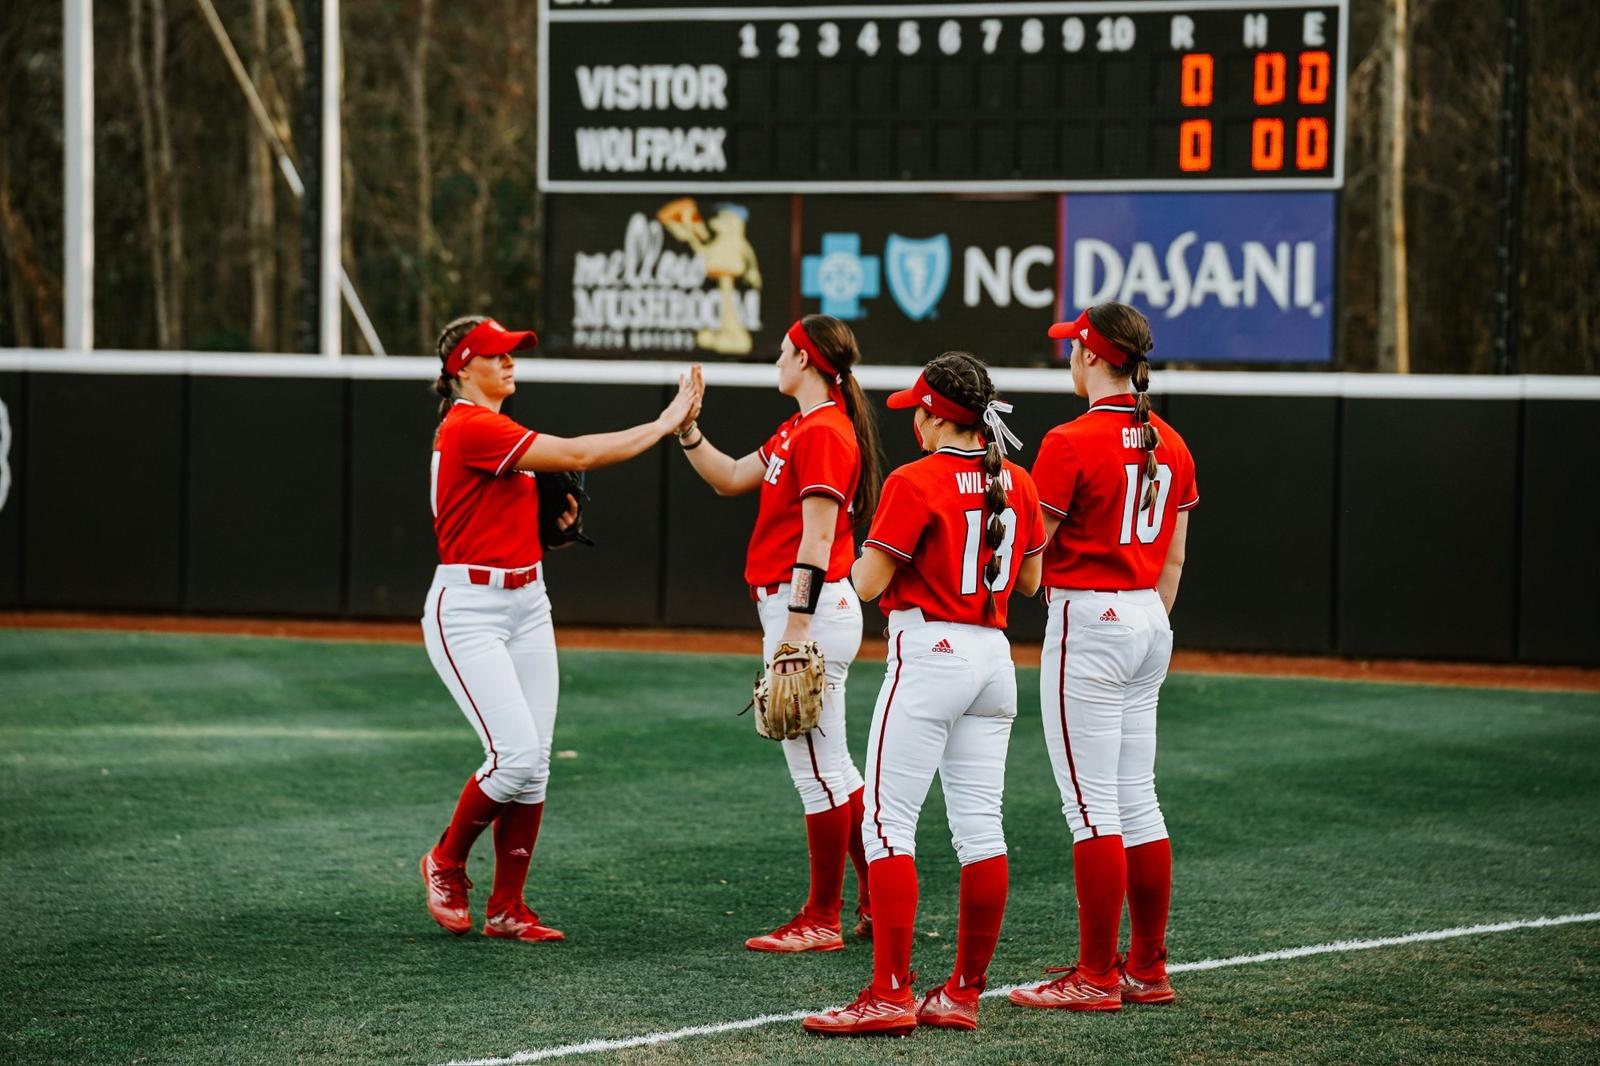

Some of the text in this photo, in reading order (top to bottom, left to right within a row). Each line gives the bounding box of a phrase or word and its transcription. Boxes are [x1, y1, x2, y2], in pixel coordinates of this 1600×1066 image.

[739, 11, 1327, 58] 1 2 3 4 5 6 7 8 9 10 R H E
[576, 65, 728, 110] VISITOR
[1180, 51, 1331, 107] 0 0 0
[576, 127, 728, 172] WOLFPACK
[1179, 117, 1328, 172] 0 0 0
[963, 245, 1055, 308] NC
[1073, 231, 1316, 319] DASANI
[955, 469, 1014, 494] WILSN
[1119, 463, 1172, 544] 10
[961, 507, 1017, 595] 13
